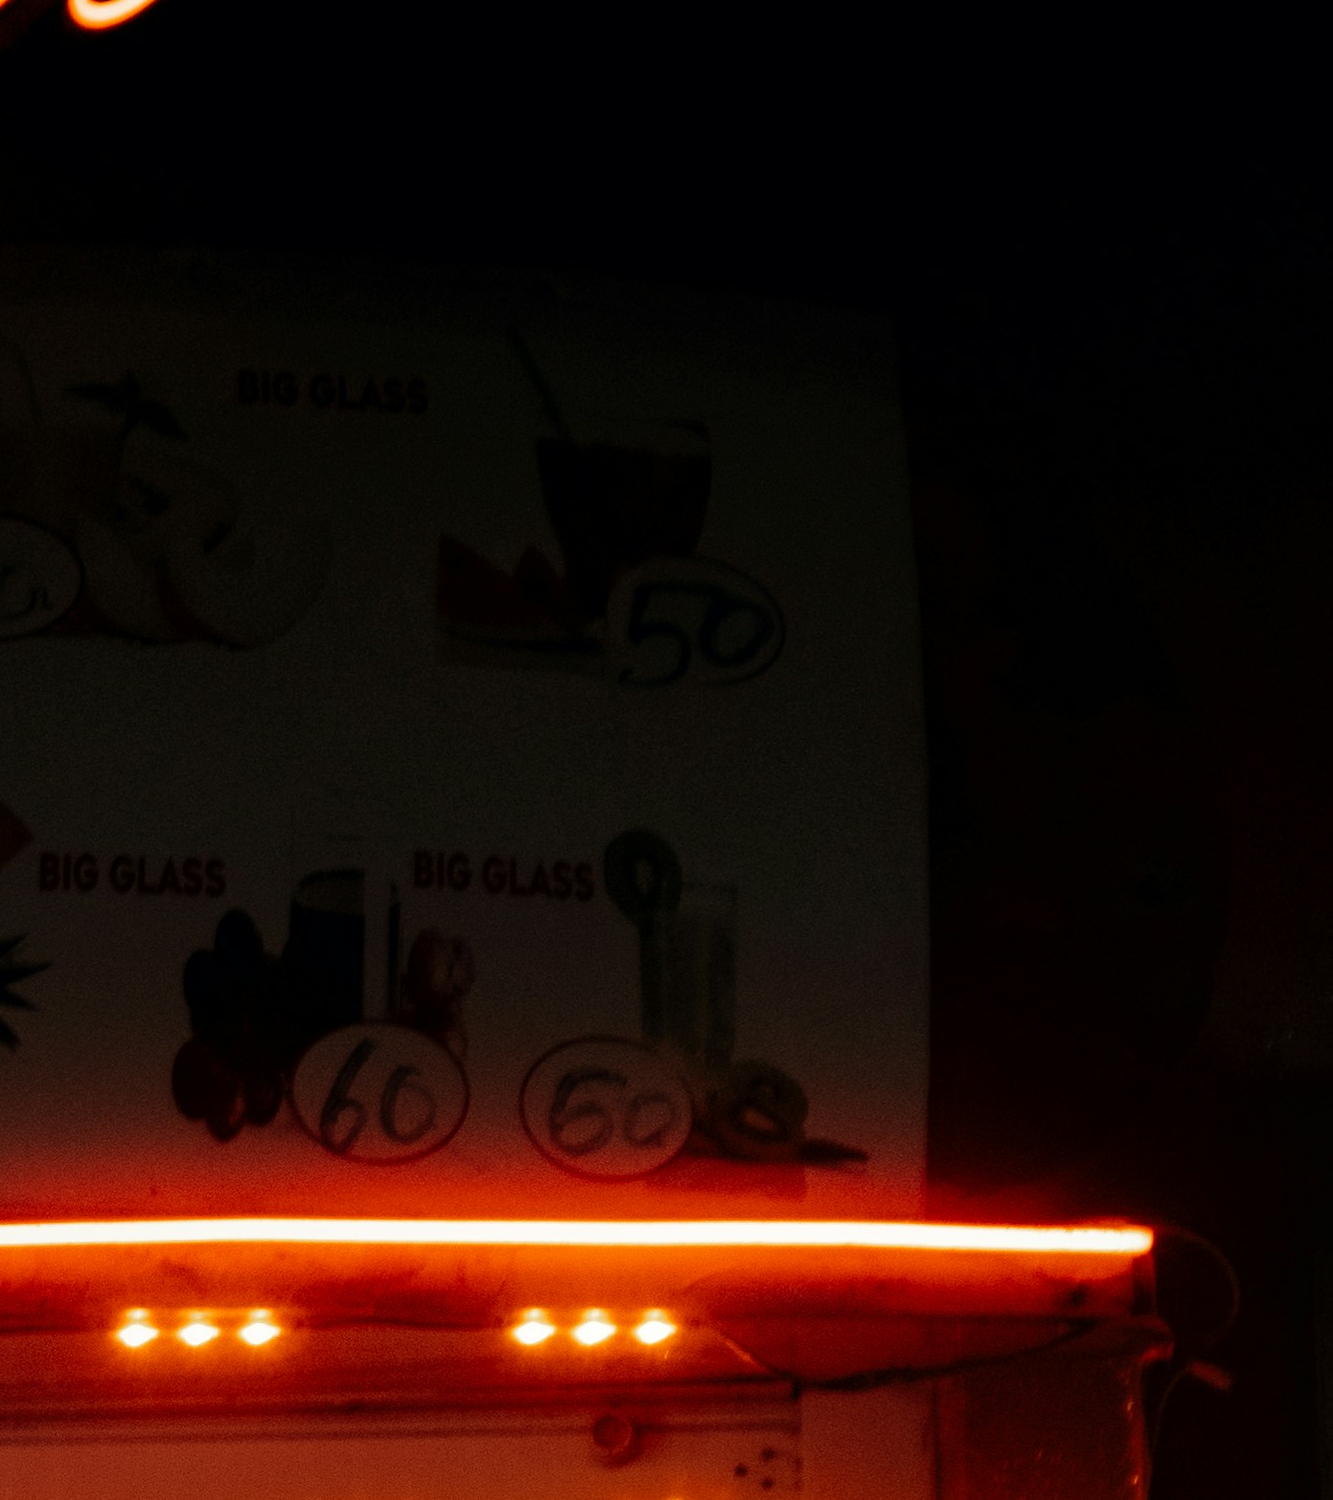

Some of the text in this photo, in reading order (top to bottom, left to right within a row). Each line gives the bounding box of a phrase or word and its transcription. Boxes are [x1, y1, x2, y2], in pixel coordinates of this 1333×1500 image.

[237, 369, 430, 415] BIG GLASS
[619, 580, 775, 688] 50
[38, 852, 227, 896] BIG GLASS
[412, 850, 596, 901] BIG GLASS
[319, 1036, 436, 1152] 60
